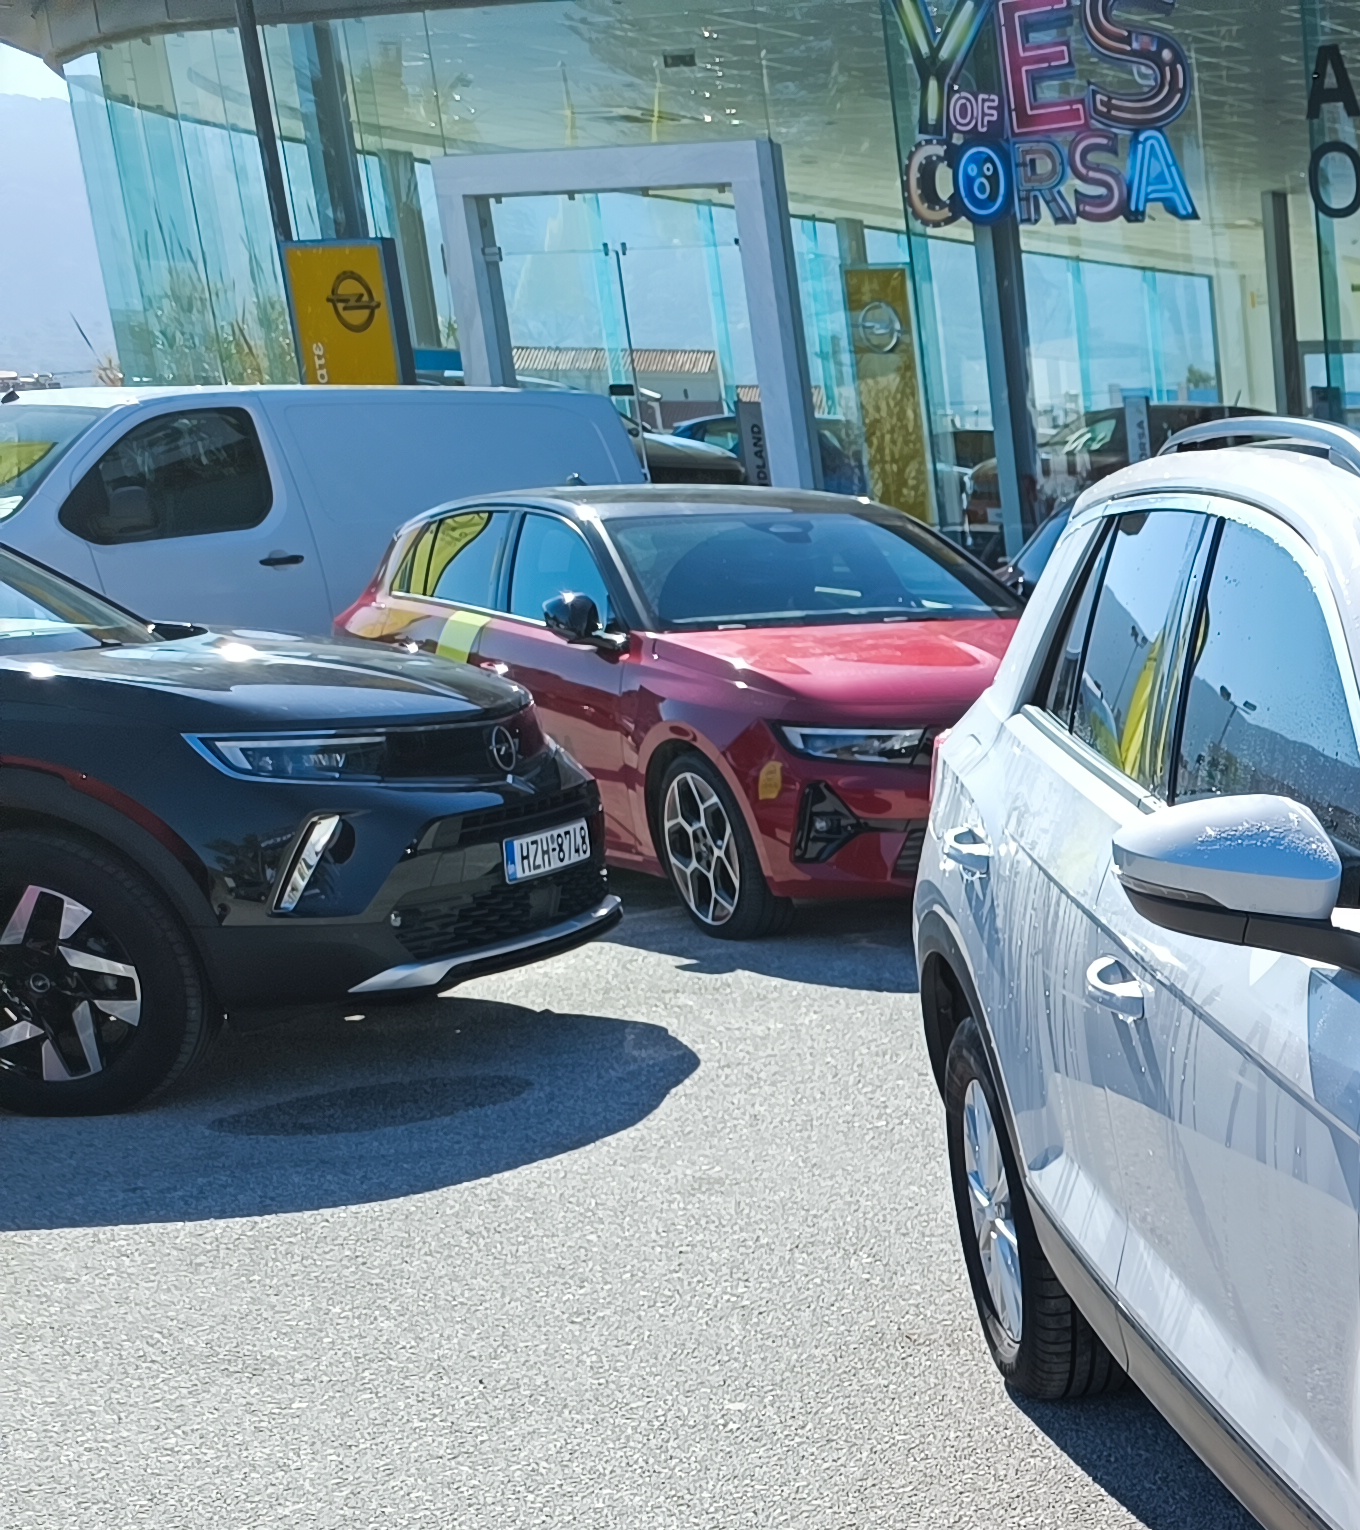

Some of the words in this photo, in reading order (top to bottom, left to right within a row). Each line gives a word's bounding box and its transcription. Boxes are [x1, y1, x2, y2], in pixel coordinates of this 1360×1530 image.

[889, 0, 1193, 138] YES
[949, 92, 999, 133] OF
[903, 128, 1201, 229] CORSA
